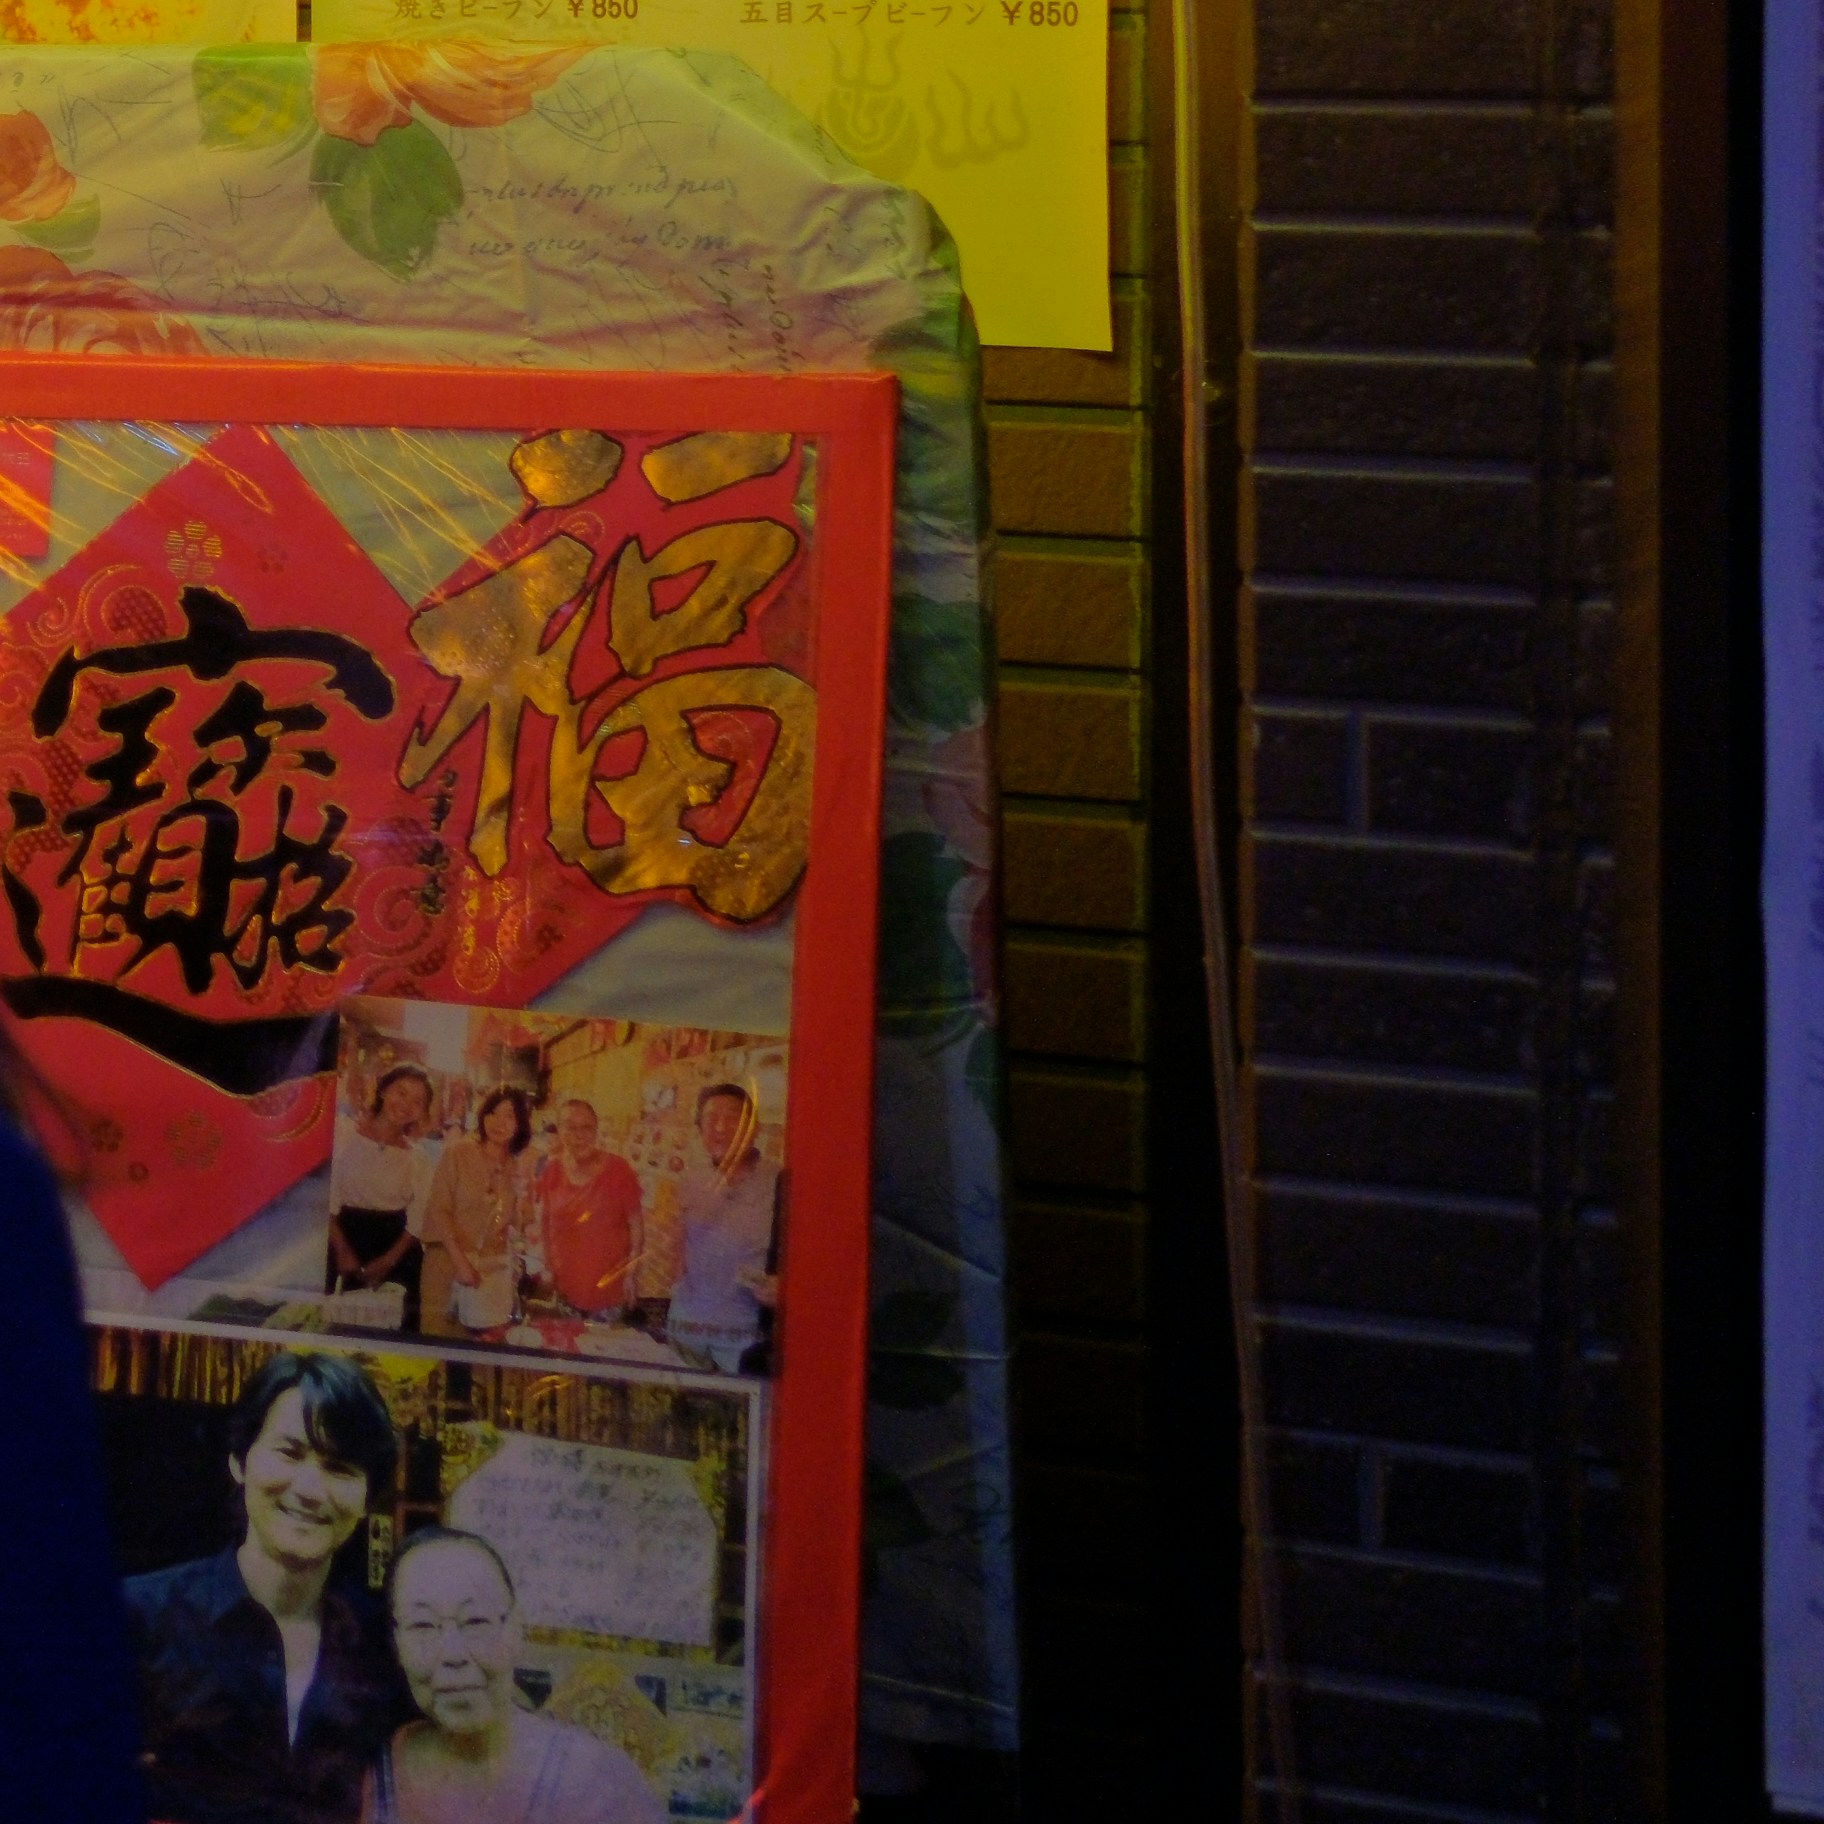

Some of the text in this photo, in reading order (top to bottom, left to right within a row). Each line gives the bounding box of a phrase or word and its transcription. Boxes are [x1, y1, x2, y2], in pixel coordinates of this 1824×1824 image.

[739, 0, 1079, 28] 五目スープビーフン ¥850
